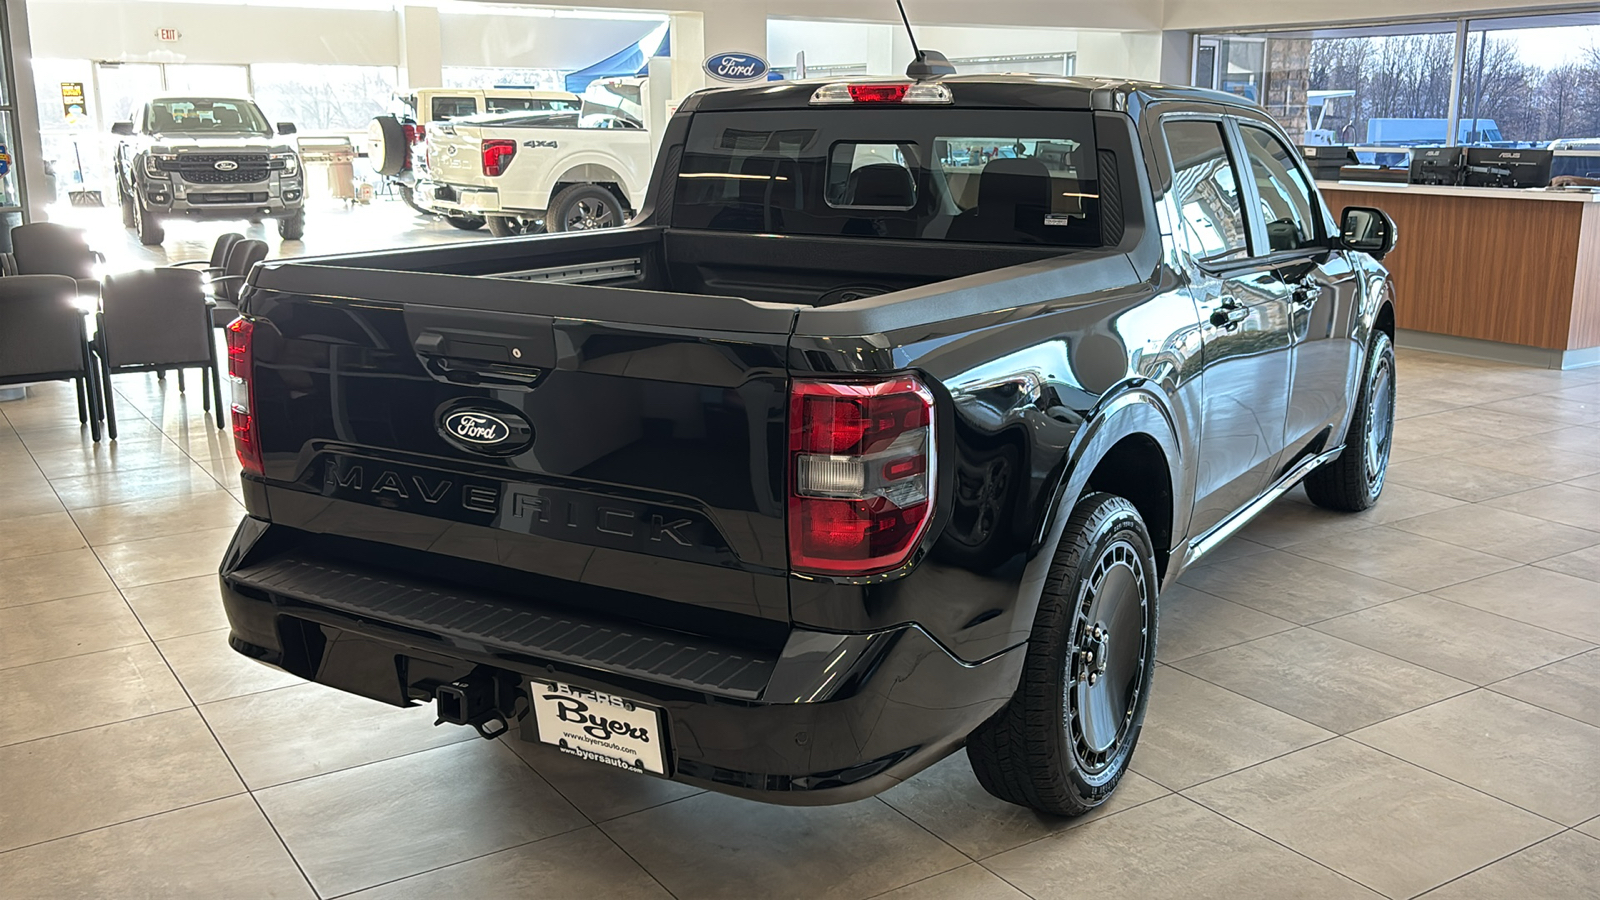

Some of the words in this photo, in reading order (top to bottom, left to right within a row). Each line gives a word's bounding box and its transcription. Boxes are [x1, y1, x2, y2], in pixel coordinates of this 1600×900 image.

[161, 29, 175, 40] EXIT
[718, 56, 756, 77] Ford
[457, 415, 497, 439] Ford
[325, 459, 693, 547] MAVERICK
[541, 694, 650, 743] Byers
[563, 731, 637, 755] www.byersauto.com
[560, 746, 644, 774] www.byersauto.com
